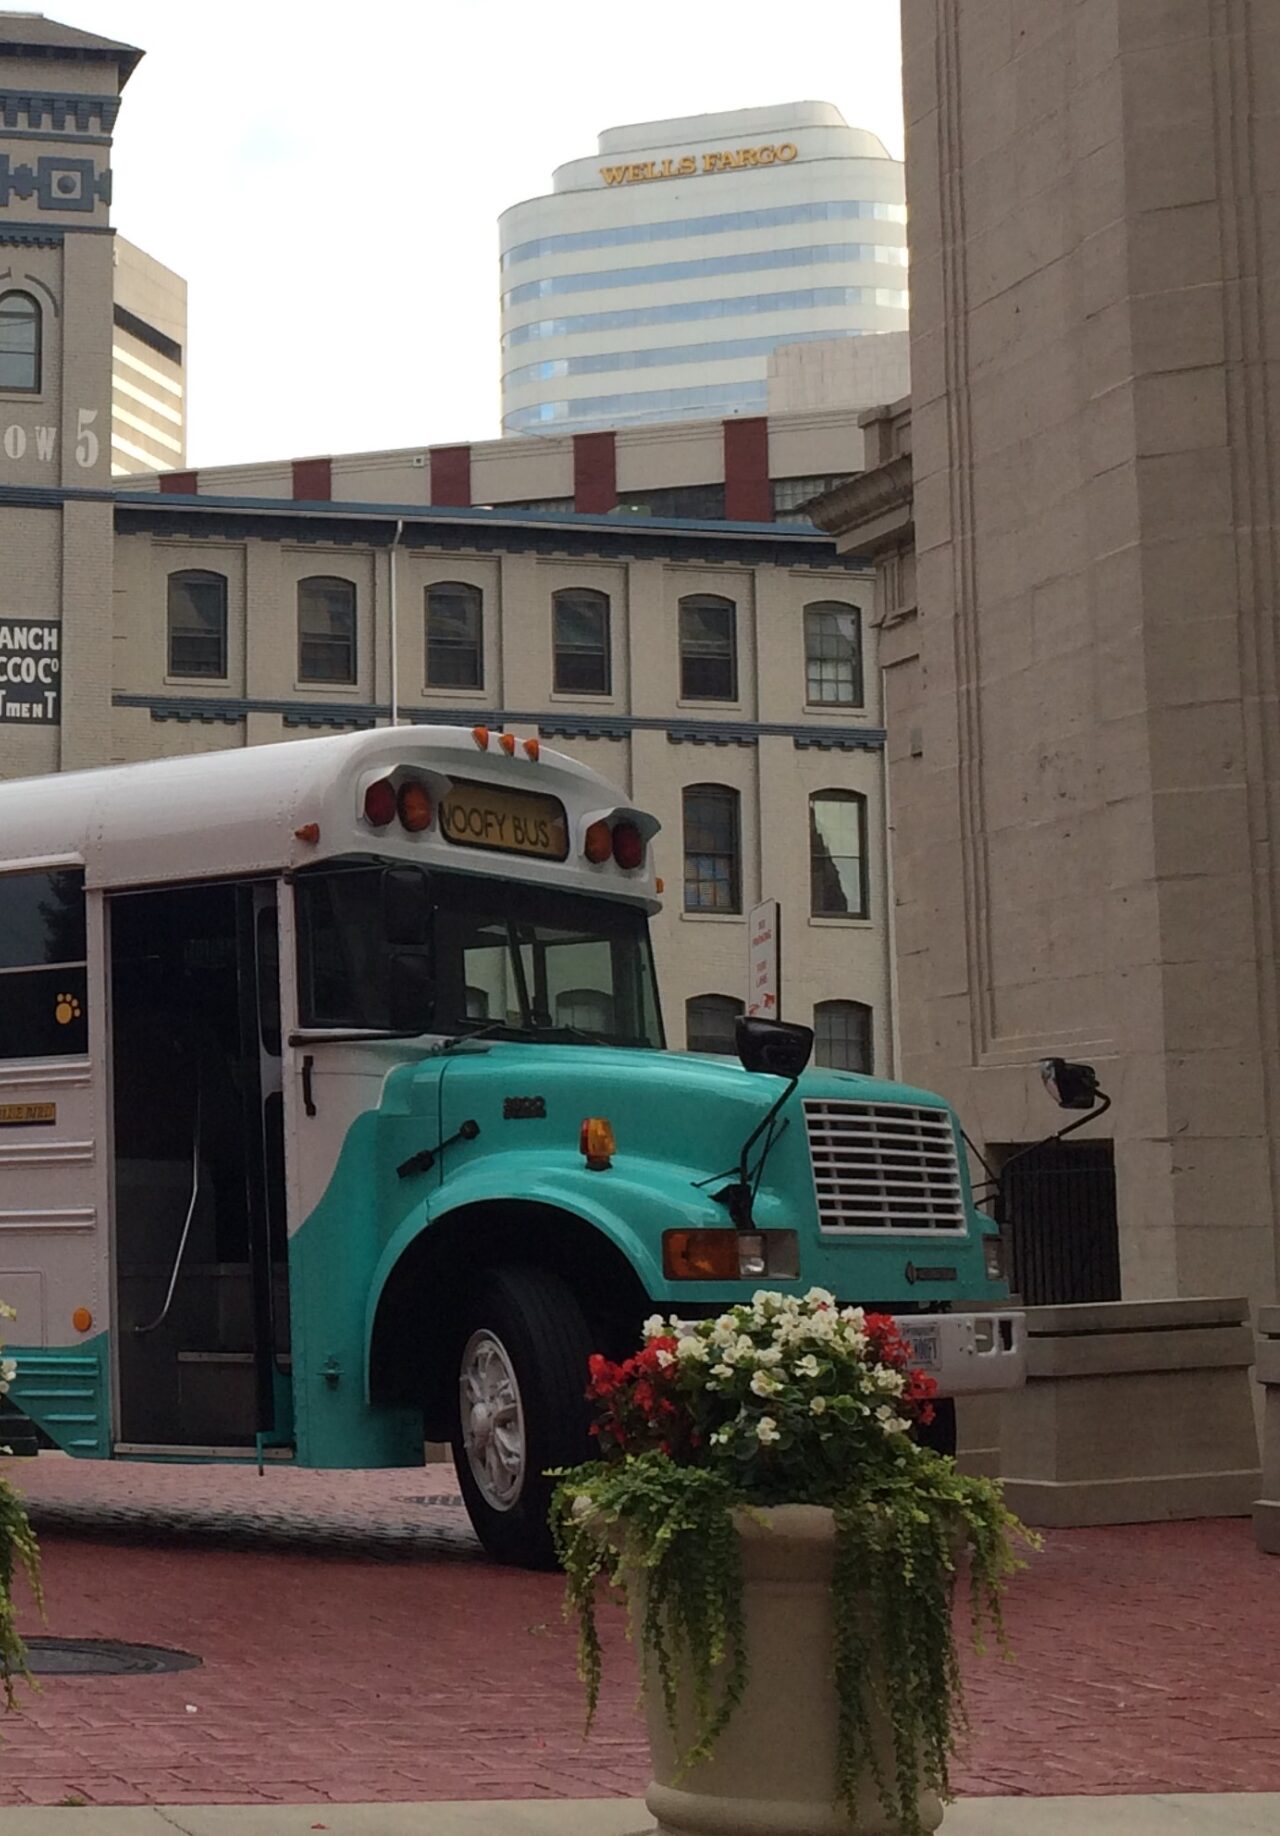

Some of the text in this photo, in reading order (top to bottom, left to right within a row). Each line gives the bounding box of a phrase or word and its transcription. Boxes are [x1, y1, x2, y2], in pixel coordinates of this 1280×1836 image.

[600, 142, 798, 186] WELLS FARGO
[75, 407, 100, 468] 5
[512, 815, 550, 849] BUS
